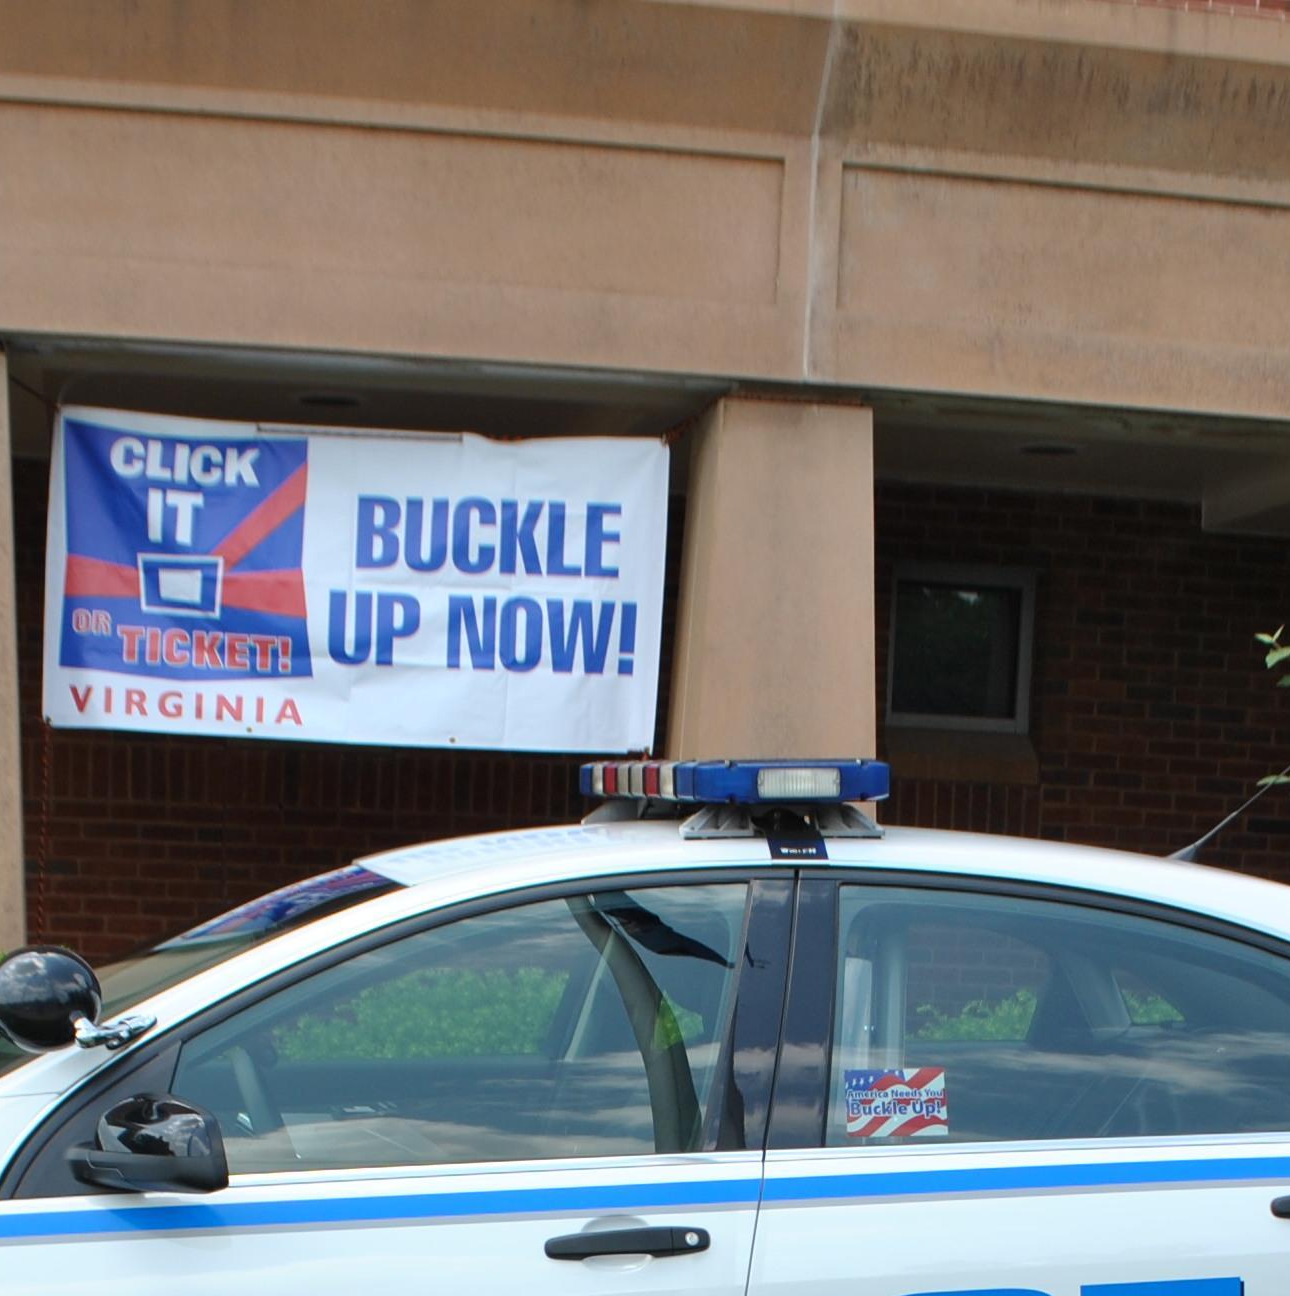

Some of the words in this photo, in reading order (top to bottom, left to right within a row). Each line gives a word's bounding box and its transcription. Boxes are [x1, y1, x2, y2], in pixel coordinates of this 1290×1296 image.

[110, 437, 259, 486] CLICK
[146, 488, 204, 546] IT
[355, 494, 622, 578] BUCKLE
[72, 608, 112, 635] OR
[327, 589, 420, 666] UP
[446, 595, 638, 675] NOW!
[117, 625, 292, 674] TICKET!
[69, 684, 304, 727] VIRGINIA
[847, 1088, 889, 1099] America
[891, 1089, 922, 1099] Needs
[851, 1101, 907, 1116] Buckle
[912, 1101, 941, 1118] Up!
